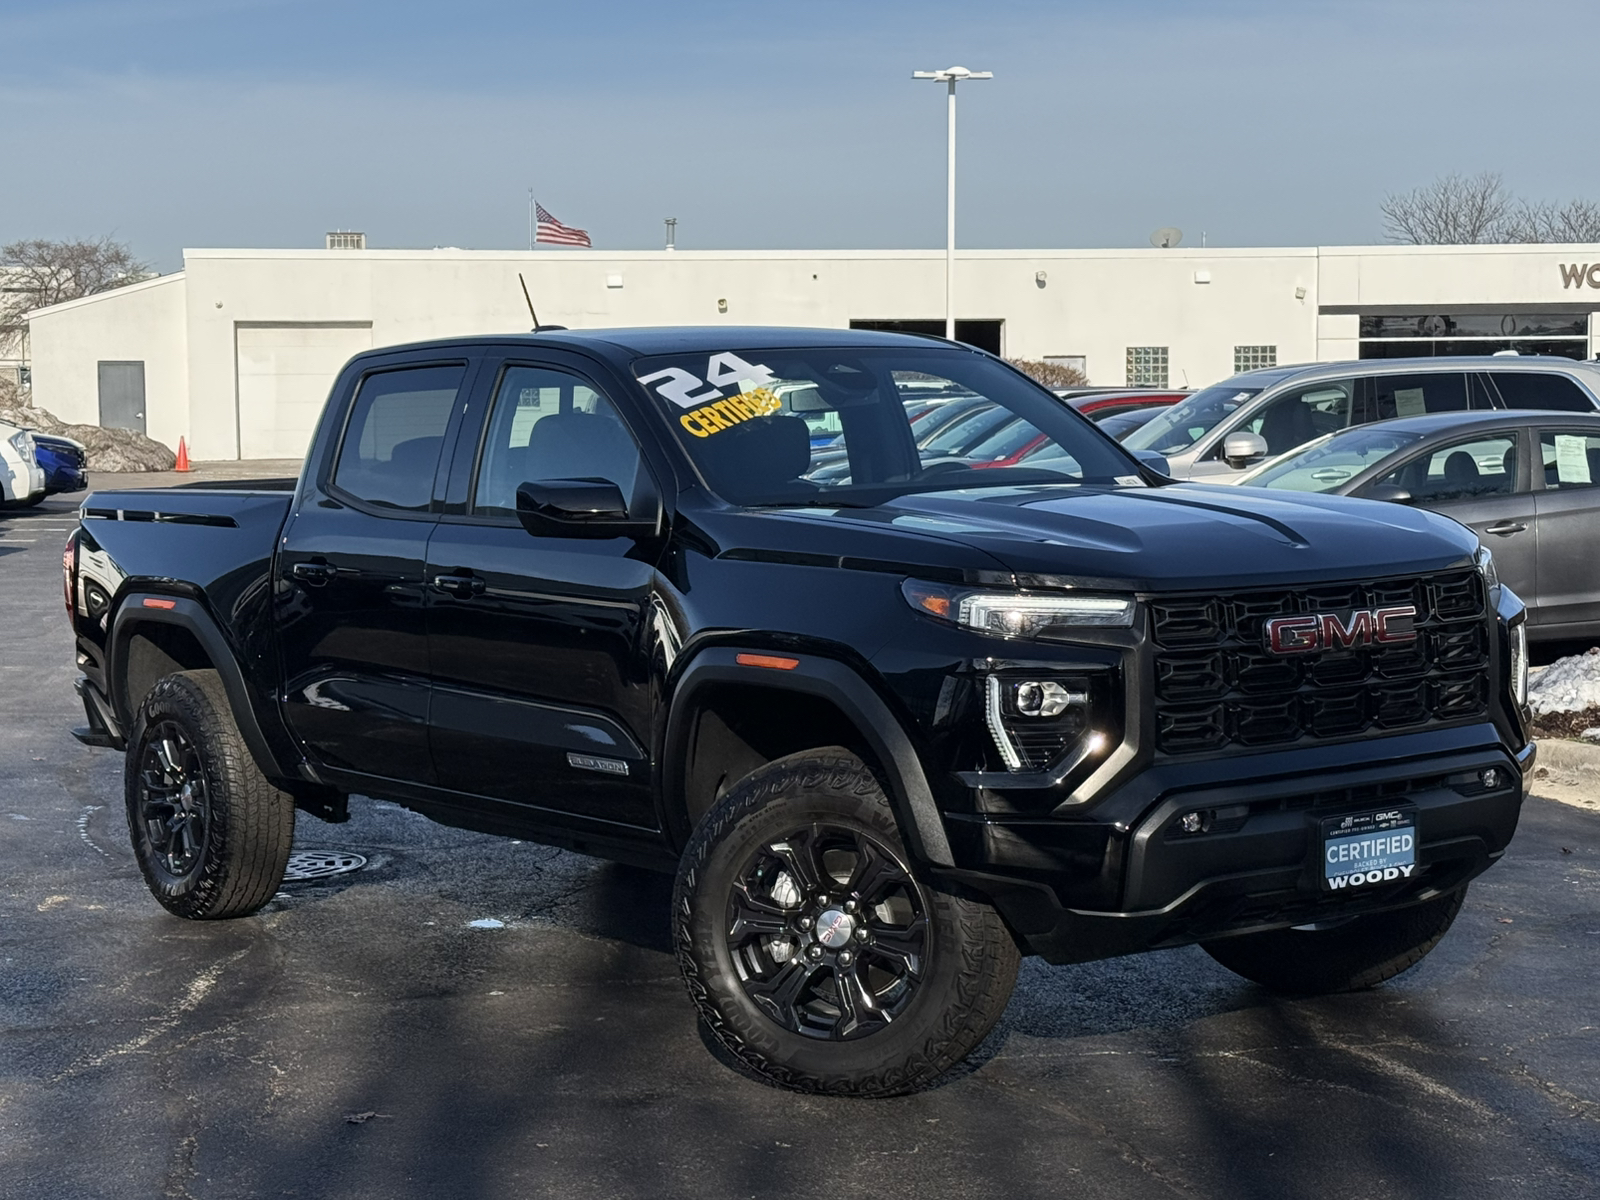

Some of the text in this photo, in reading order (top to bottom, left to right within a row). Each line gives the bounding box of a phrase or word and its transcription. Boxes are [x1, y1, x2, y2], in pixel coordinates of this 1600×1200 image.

[636, 351, 777, 409] 24
[1266, 606, 1417, 654] GMC
[1375, 811, 1399, 821] GMC
[1327, 834, 1413, 864] CERTIFIED
[1328, 864, 1415, 890] WOODY
[1354, 859, 1378, 868] BACKED
